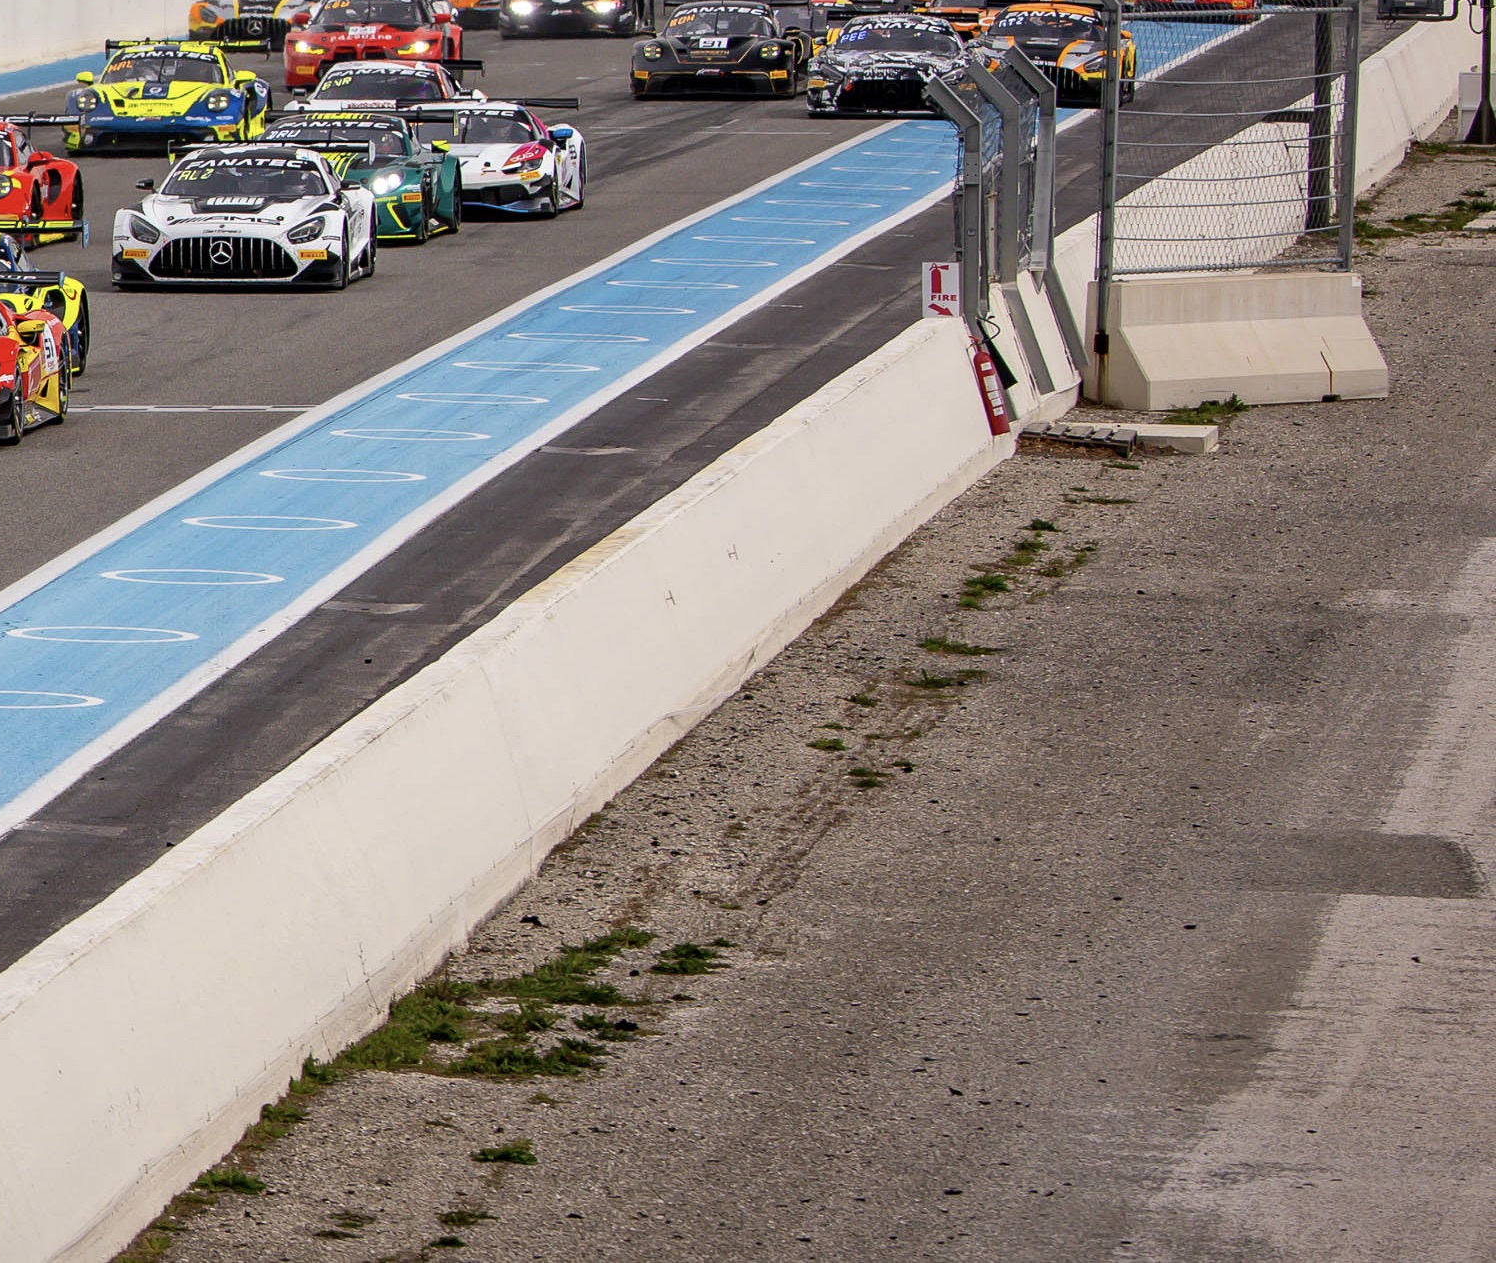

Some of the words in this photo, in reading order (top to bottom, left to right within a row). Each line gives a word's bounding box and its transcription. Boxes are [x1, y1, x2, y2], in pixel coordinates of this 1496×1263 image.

[1005, 10, 1100, 23] FANATEC
[848, 22, 946, 34] FANATEC
[121, 51, 217, 62] FANATEC
[278, 121, 394, 130] FANATEC
[187, 158, 307, 170] FANATEC
[930, 294, 957, 302] FIRE
